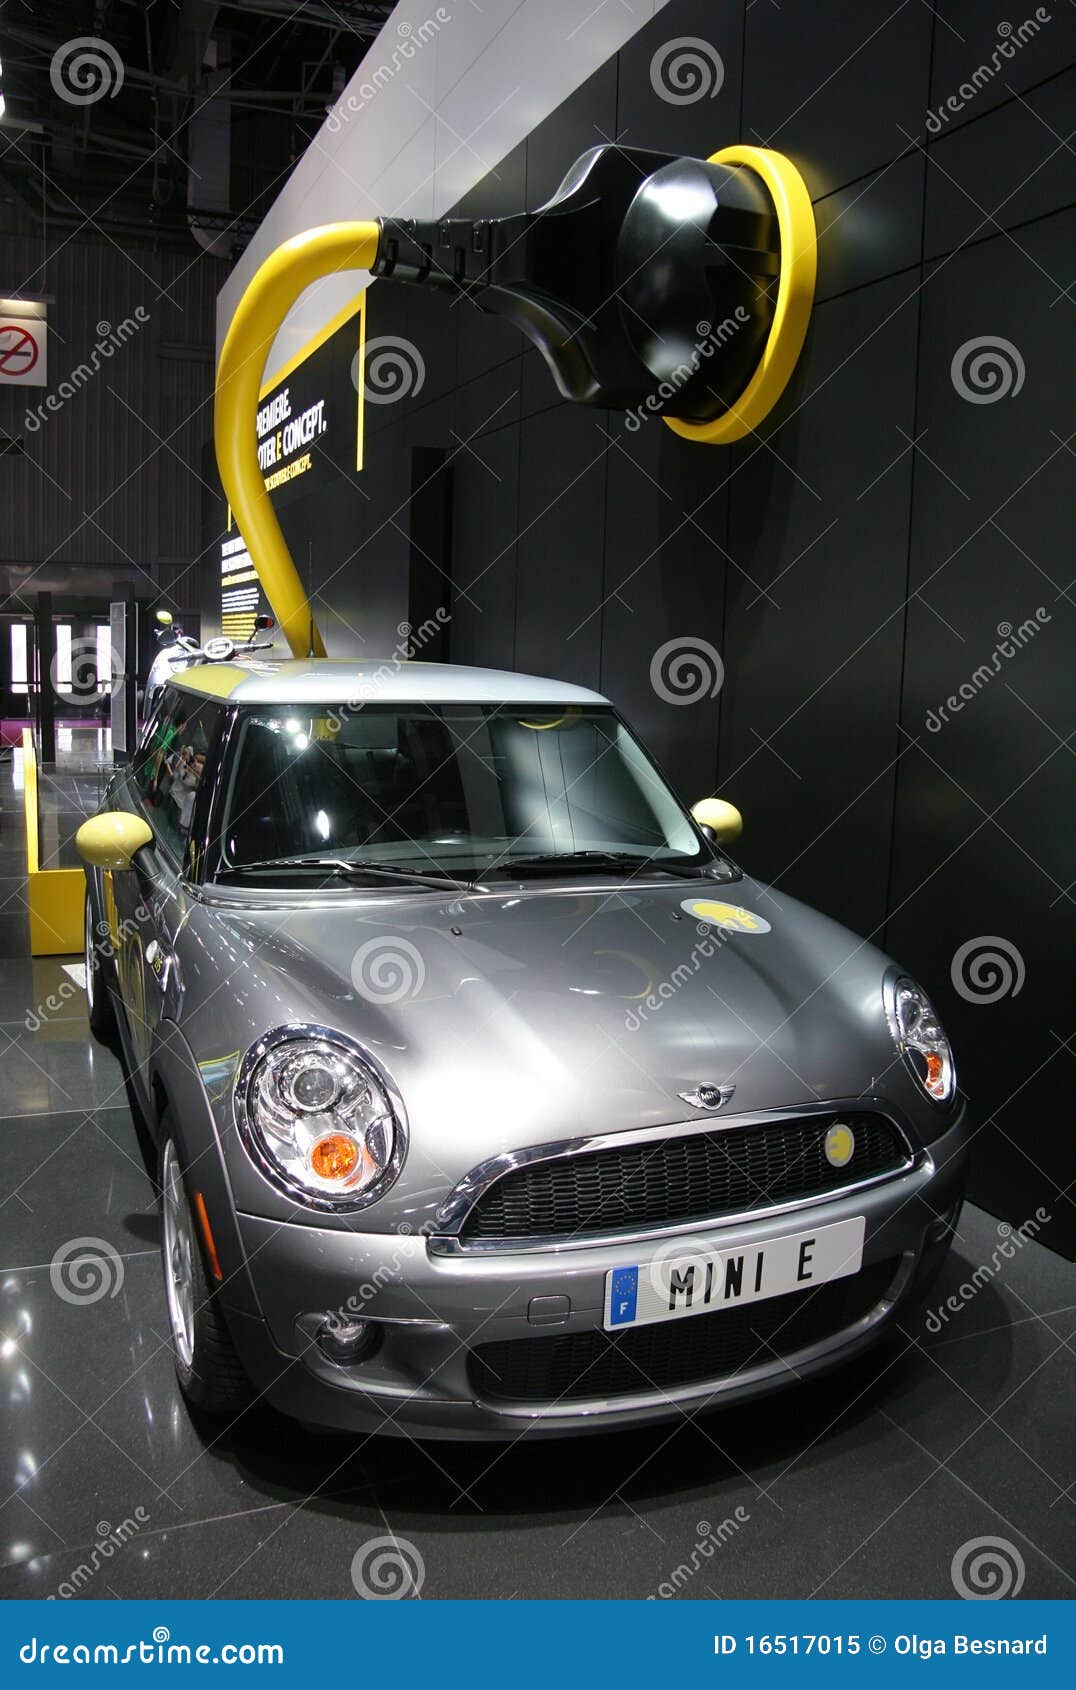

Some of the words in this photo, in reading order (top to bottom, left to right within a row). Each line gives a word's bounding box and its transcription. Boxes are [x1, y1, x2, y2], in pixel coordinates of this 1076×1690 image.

[258, 436, 276, 470] OTER
[276, 431, 282, 461] E
[283, 400, 327, 456] CONCEPT.
[619, 1302, 628, 1315] F
[668, 1252, 764, 1311] MINI
[797, 1238, 816, 1282] E
